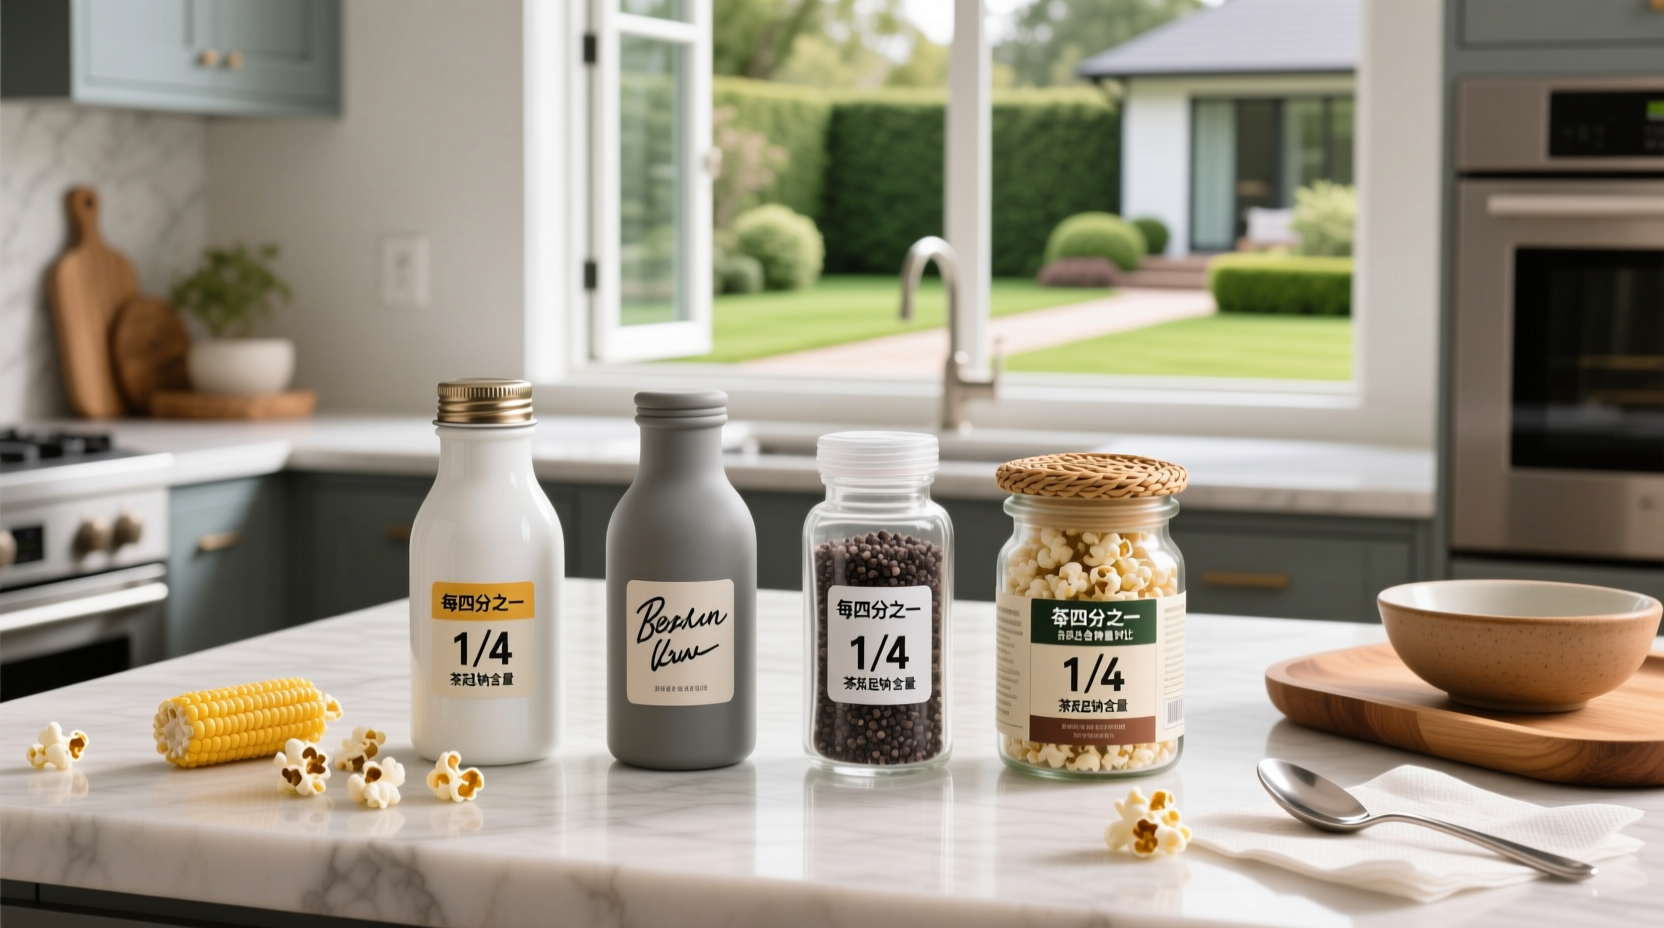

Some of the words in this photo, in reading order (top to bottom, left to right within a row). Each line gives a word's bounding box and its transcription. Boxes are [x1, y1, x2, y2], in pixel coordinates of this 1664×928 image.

[441, 593, 524, 612] 每四分之一
[836, 599, 921, 619] 每四分之一
[454, 629, 512, 667] 1/4
[850, 634, 909, 672] 1/4
[1063, 653, 1125, 693] 1/4
